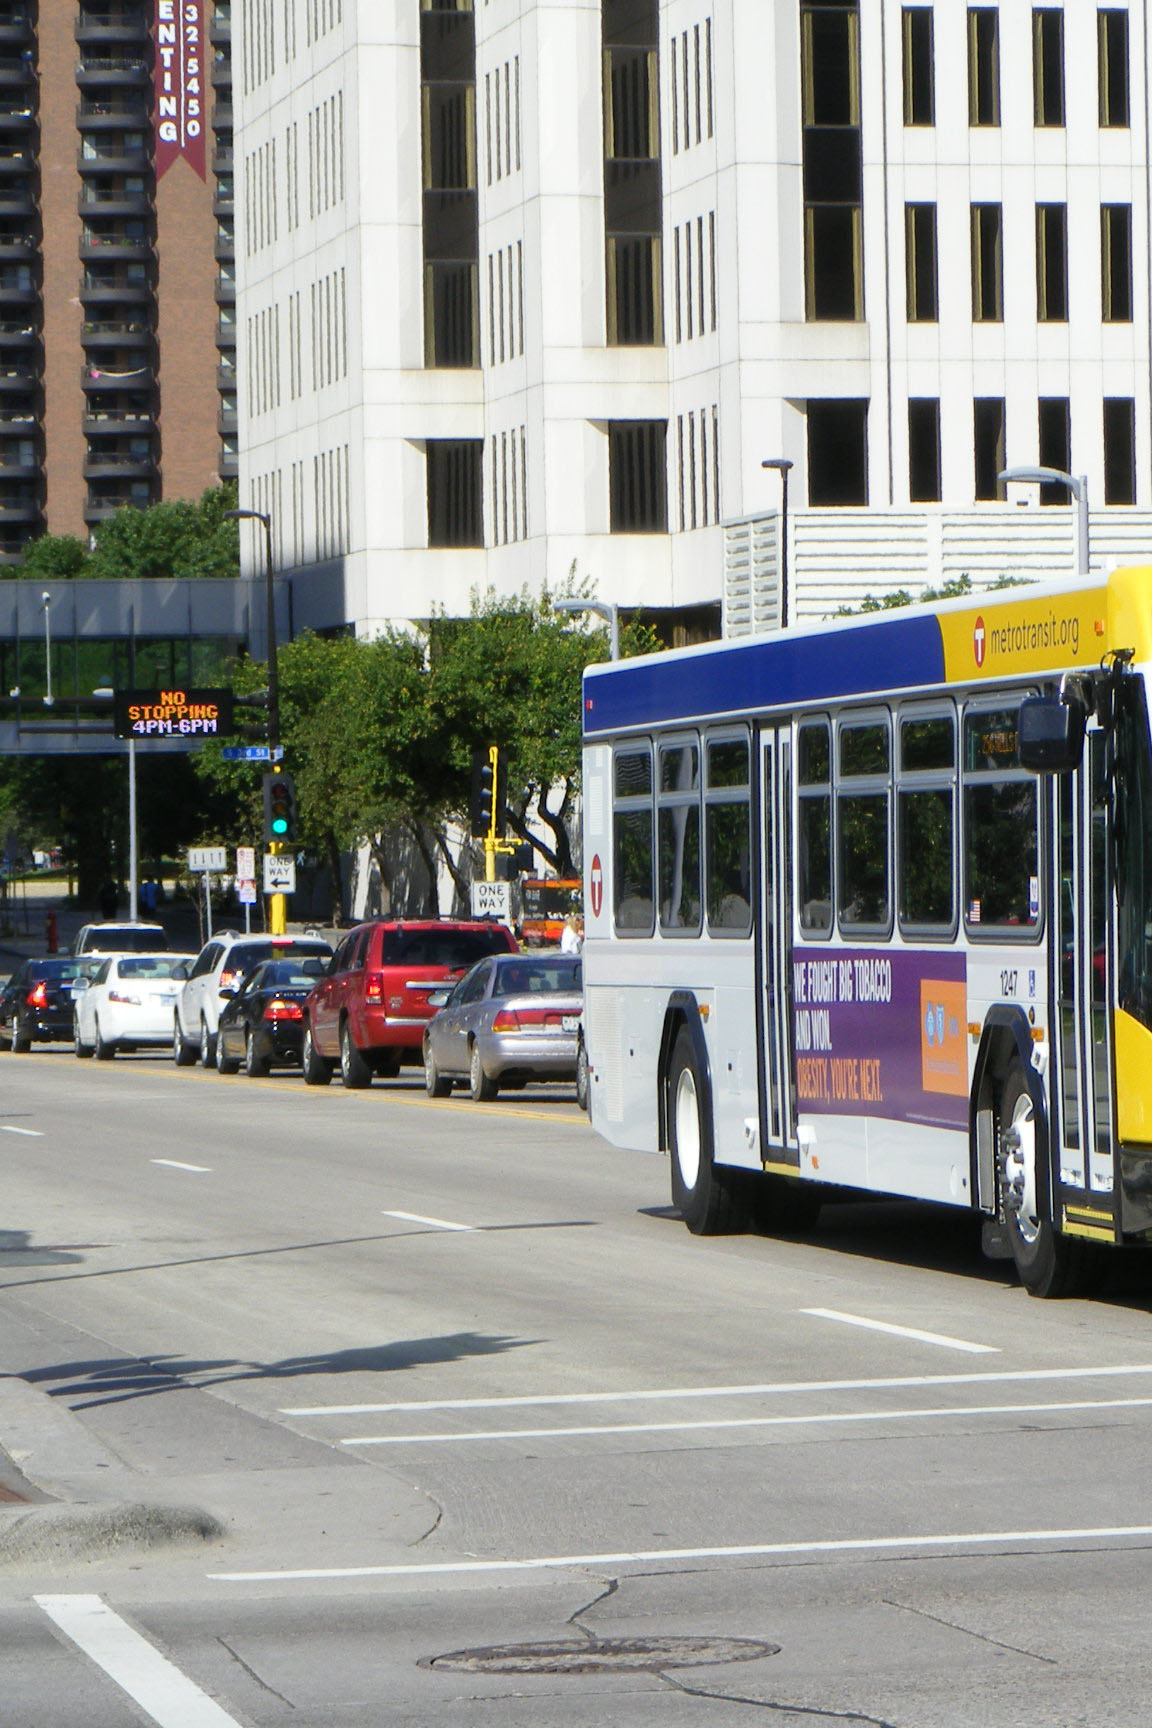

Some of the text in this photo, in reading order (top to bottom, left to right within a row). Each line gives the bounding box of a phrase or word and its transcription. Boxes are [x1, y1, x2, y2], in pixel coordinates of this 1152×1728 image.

[990, 610, 1080, 656] metrotransit.org
[160, 691, 186, 705] NO
[128, 705, 219, 720] STOPPING
[132, 719, 218, 734] 4PM-6PM
[269, 857, 290, 866] ONE
[269, 868, 290, 876] WAY
[479, 884, 504, 897] ONE
[479, 898, 505, 909] WAY
[793, 959, 892, 1002] WE FOUGHT BIG TOBACCO
[1000, 969, 1018, 996] 1247
[795, 1010, 832, 1050] AND WON.
[797, 1058, 883, 1104] OBESITY, YOU'RE NEXT.
